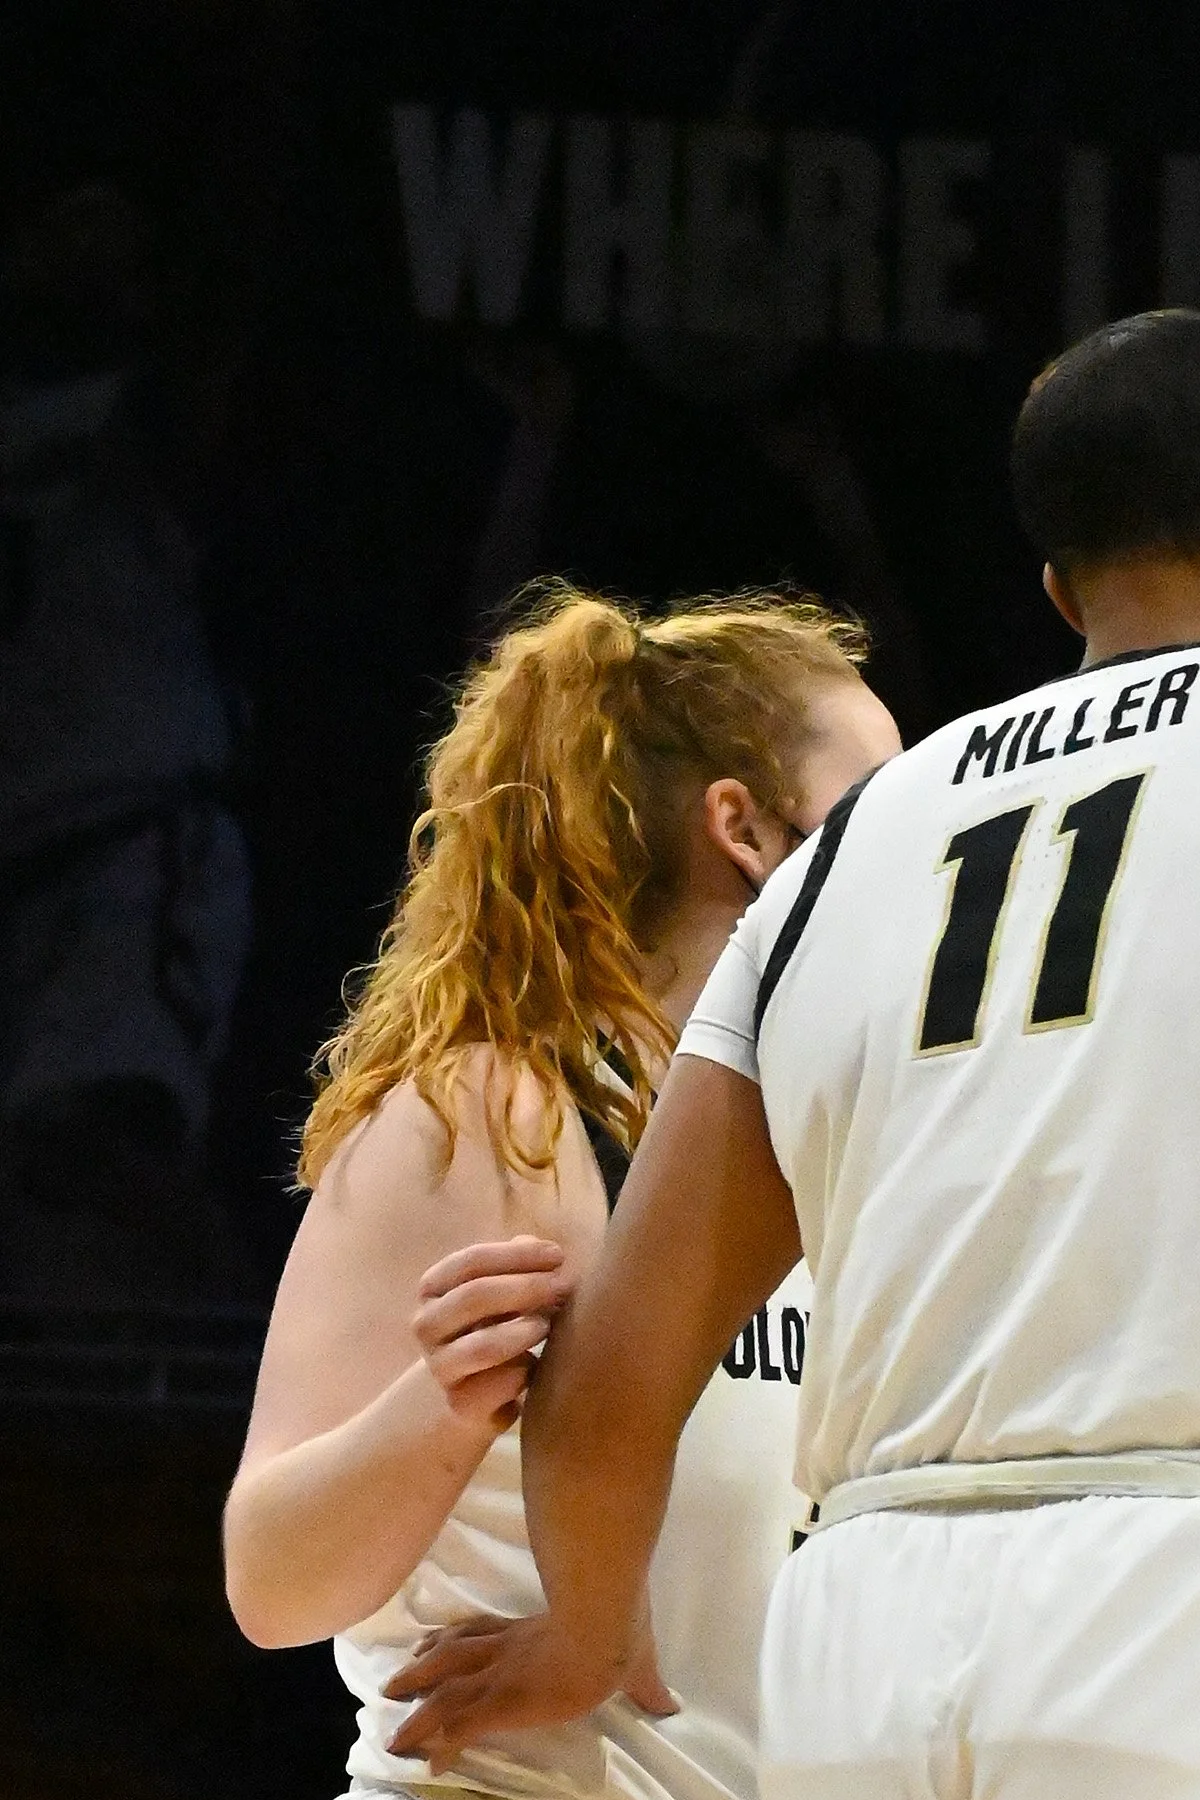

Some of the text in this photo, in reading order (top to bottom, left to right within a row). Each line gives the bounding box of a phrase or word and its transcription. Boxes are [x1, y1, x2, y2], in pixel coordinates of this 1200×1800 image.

[392, 103, 992, 355] WHERE
[950, 662, 1200, 786] MILLER
[912, 765, 1156, 1061] 11
[721, 1300, 811, 1386] OLO
